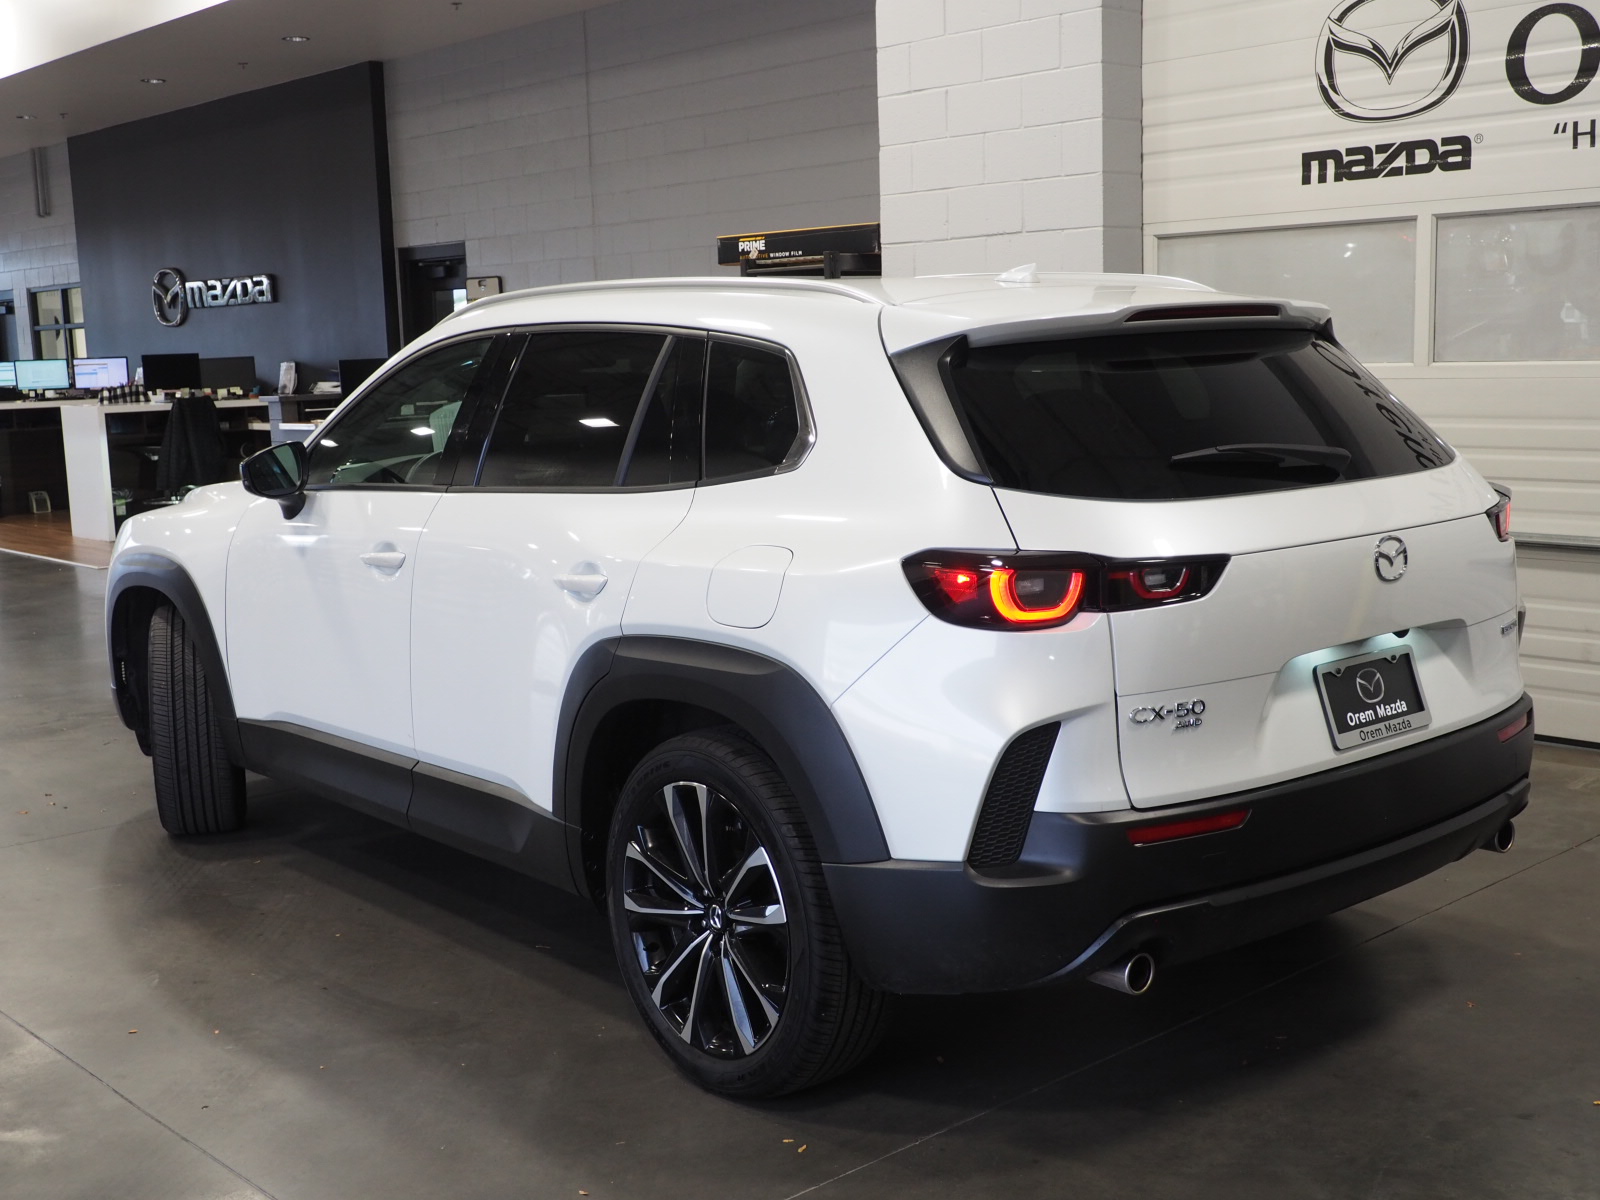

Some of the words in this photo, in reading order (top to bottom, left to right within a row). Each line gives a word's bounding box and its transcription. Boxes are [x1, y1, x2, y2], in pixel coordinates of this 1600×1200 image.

[738, 240, 766, 252] PRIME
[1129, 698, 1206, 723] CX-50
[1346, 709, 1376, 726] Orem
[1376, 699, 1408, 719] Mazda
[1359, 727, 1384, 742] Orem
[1384, 718, 1412, 735] Mazda
